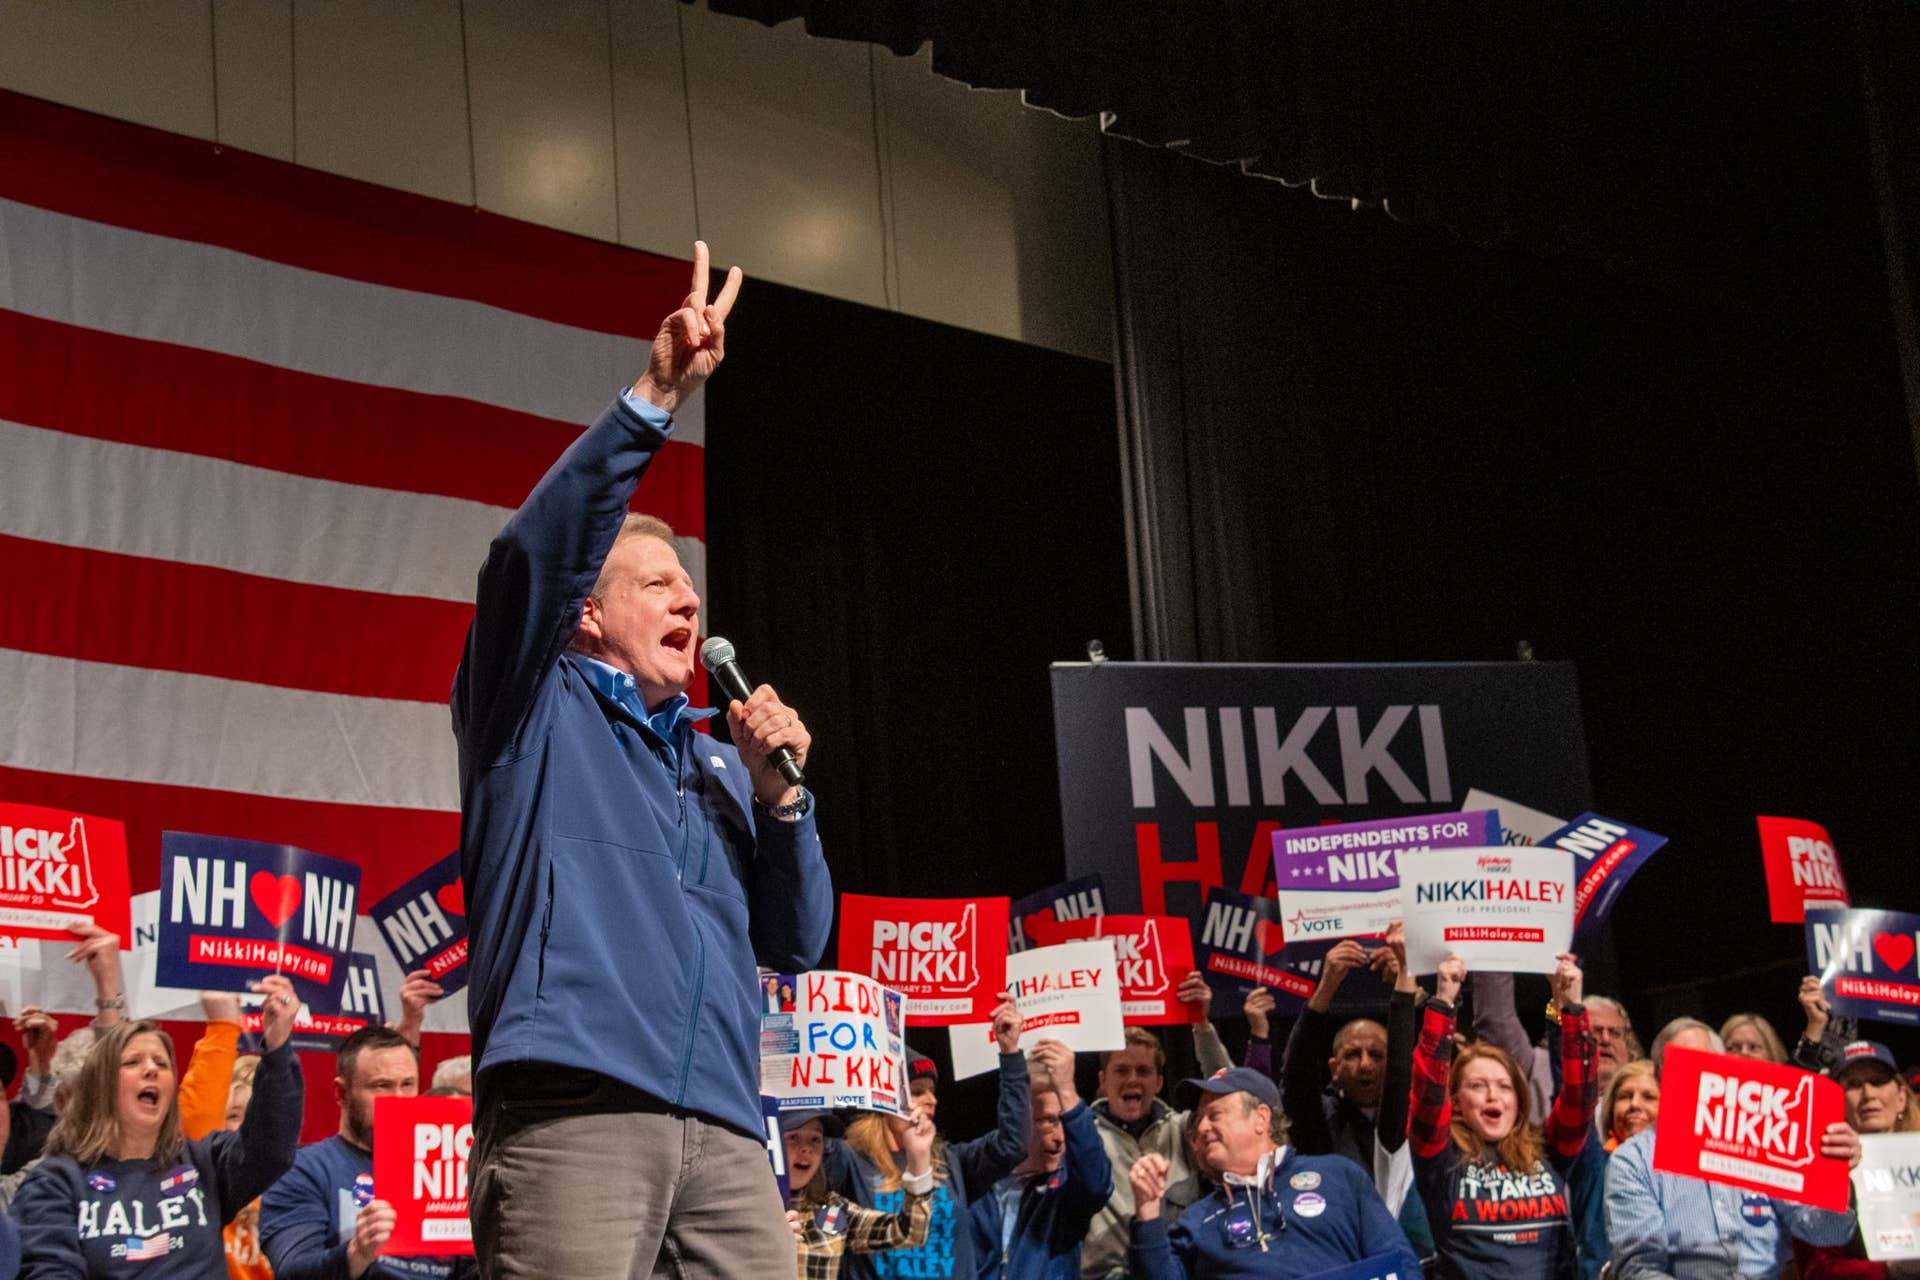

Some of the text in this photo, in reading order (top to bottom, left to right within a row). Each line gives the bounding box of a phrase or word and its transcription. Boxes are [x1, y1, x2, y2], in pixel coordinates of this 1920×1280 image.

[1125, 704, 1453, 807] NIKKI
[1286, 822, 1469, 854] INDEPENDENTS FOR
[1555, 818, 1628, 860] NH
[0, 857, 81, 896] IKKI
[1327, 846, 1431, 883] NIK
[171, 856, 355, 952] NH NH
[1055, 888, 1104, 922] NH
[1417, 879, 1565, 904] NIKKIHALEY
[383, 890, 454, 964] NH
[873, 919, 958, 952] PICK
[1201, 901, 1257, 954] NH
[1303, 918, 1343, 932] VOTE
[1448, 929, 1540, 940] NikkiHaley.com
[200, 940, 327, 976] NikkiHaley.com
[871, 949, 967, 983] NIKKI
[1214, 957, 1309, 993] NikkiHaley.com
[808, 973, 880, 1018] KIDS
[921, 985, 932, 994] 23
[808, 1022, 877, 1053] FOR
[791, 1054, 895, 1092] NIKKI
[1699, 1072, 1791, 1120] PICK
[1694, 1103, 1799, 1156] NIKKI
[1459, 1172, 1556, 1202] IT TAKES
[78, 1187, 208, 1239] HALEY
[1451, 1193, 1568, 1222] A WOMAN
